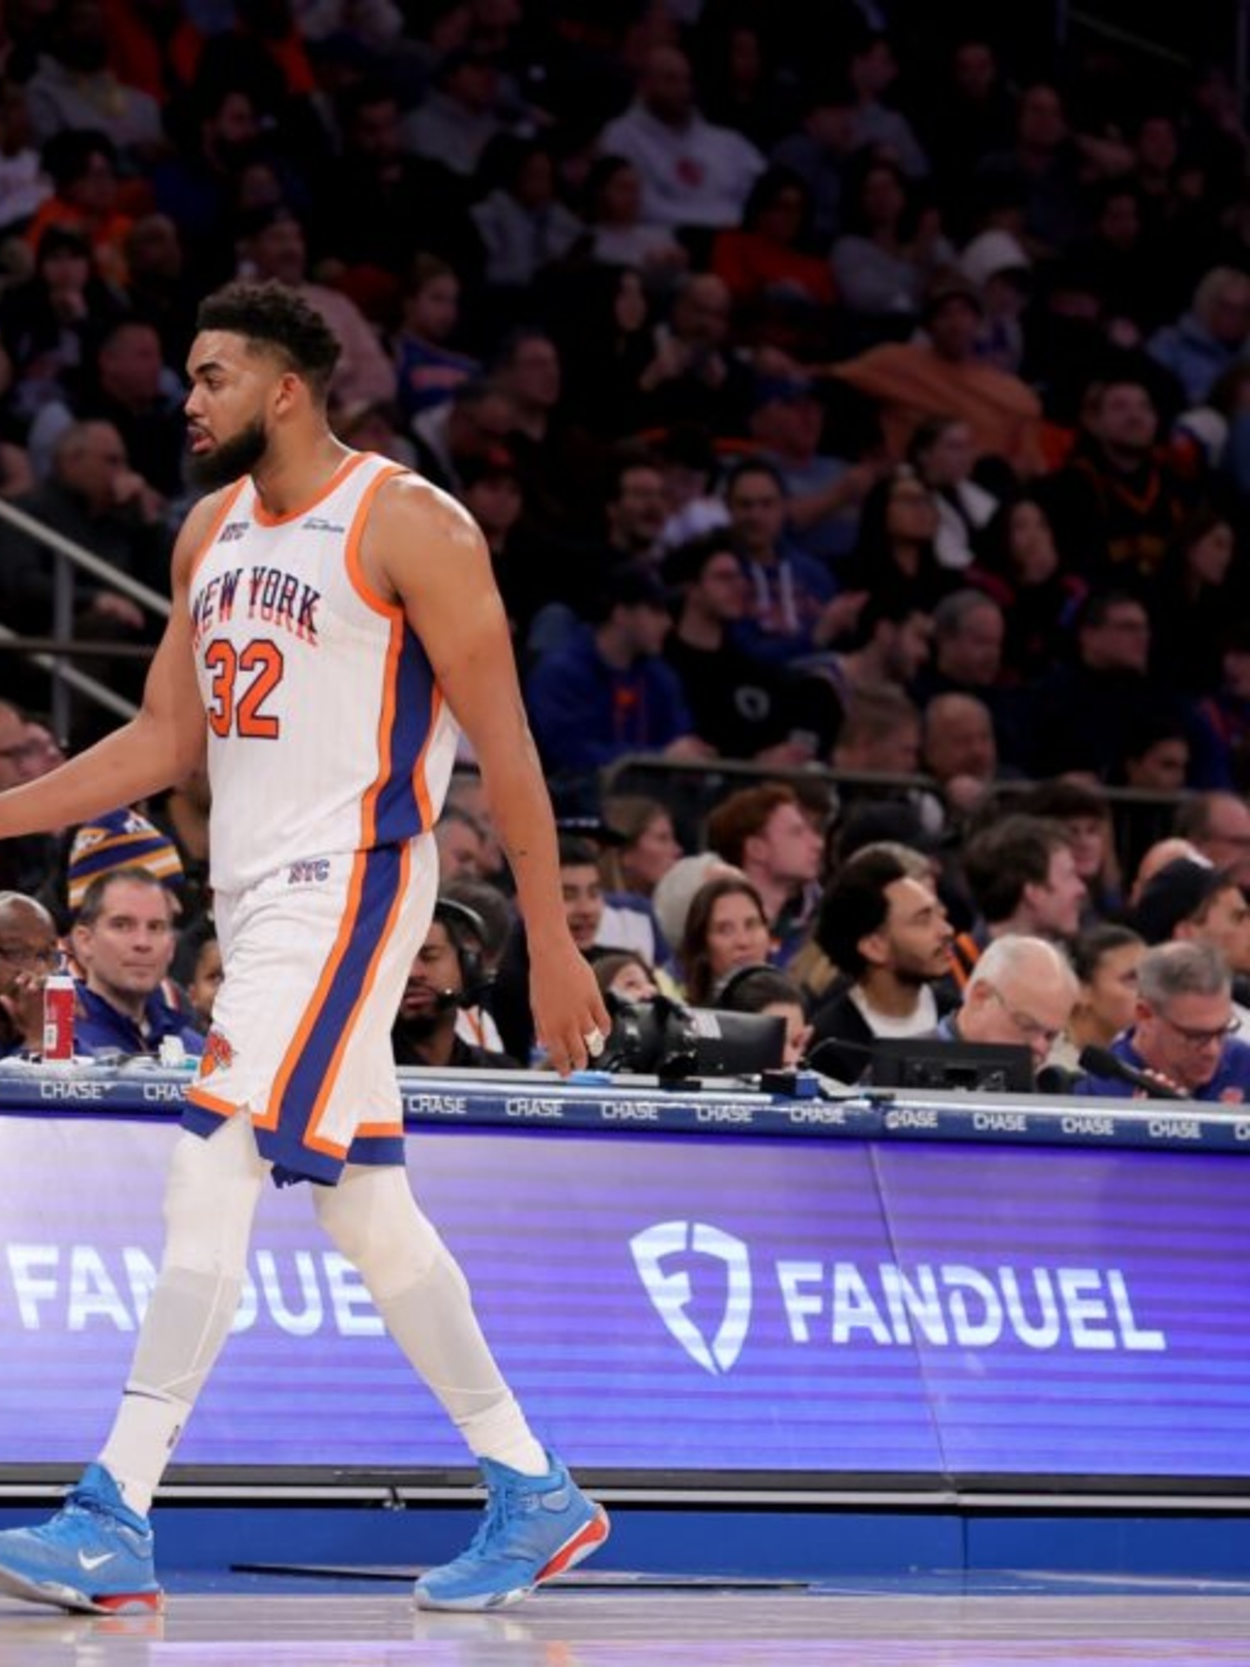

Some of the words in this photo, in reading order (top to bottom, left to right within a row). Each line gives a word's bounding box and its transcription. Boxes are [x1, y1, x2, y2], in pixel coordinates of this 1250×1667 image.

[191, 567, 244, 640] NEW
[251, 565, 321, 645] YORK
[205, 638, 284, 740] 32
[40, 1081, 103, 1099] CHASE
[407, 1094, 467, 1114] CHASE
[505, 1098, 563, 1117] CHASE
[601, 1101, 659, 1120] CHASE
[696, 1104, 754, 1123] CHASE
[790, 1106, 846, 1124] CHASE
[973, 1112, 1027, 1132] CHASE
[1061, 1116, 1114, 1136] CHASE
[1149, 1119, 1201, 1139] CHASE
[776, 1261, 1166, 1351] FANDUEL
